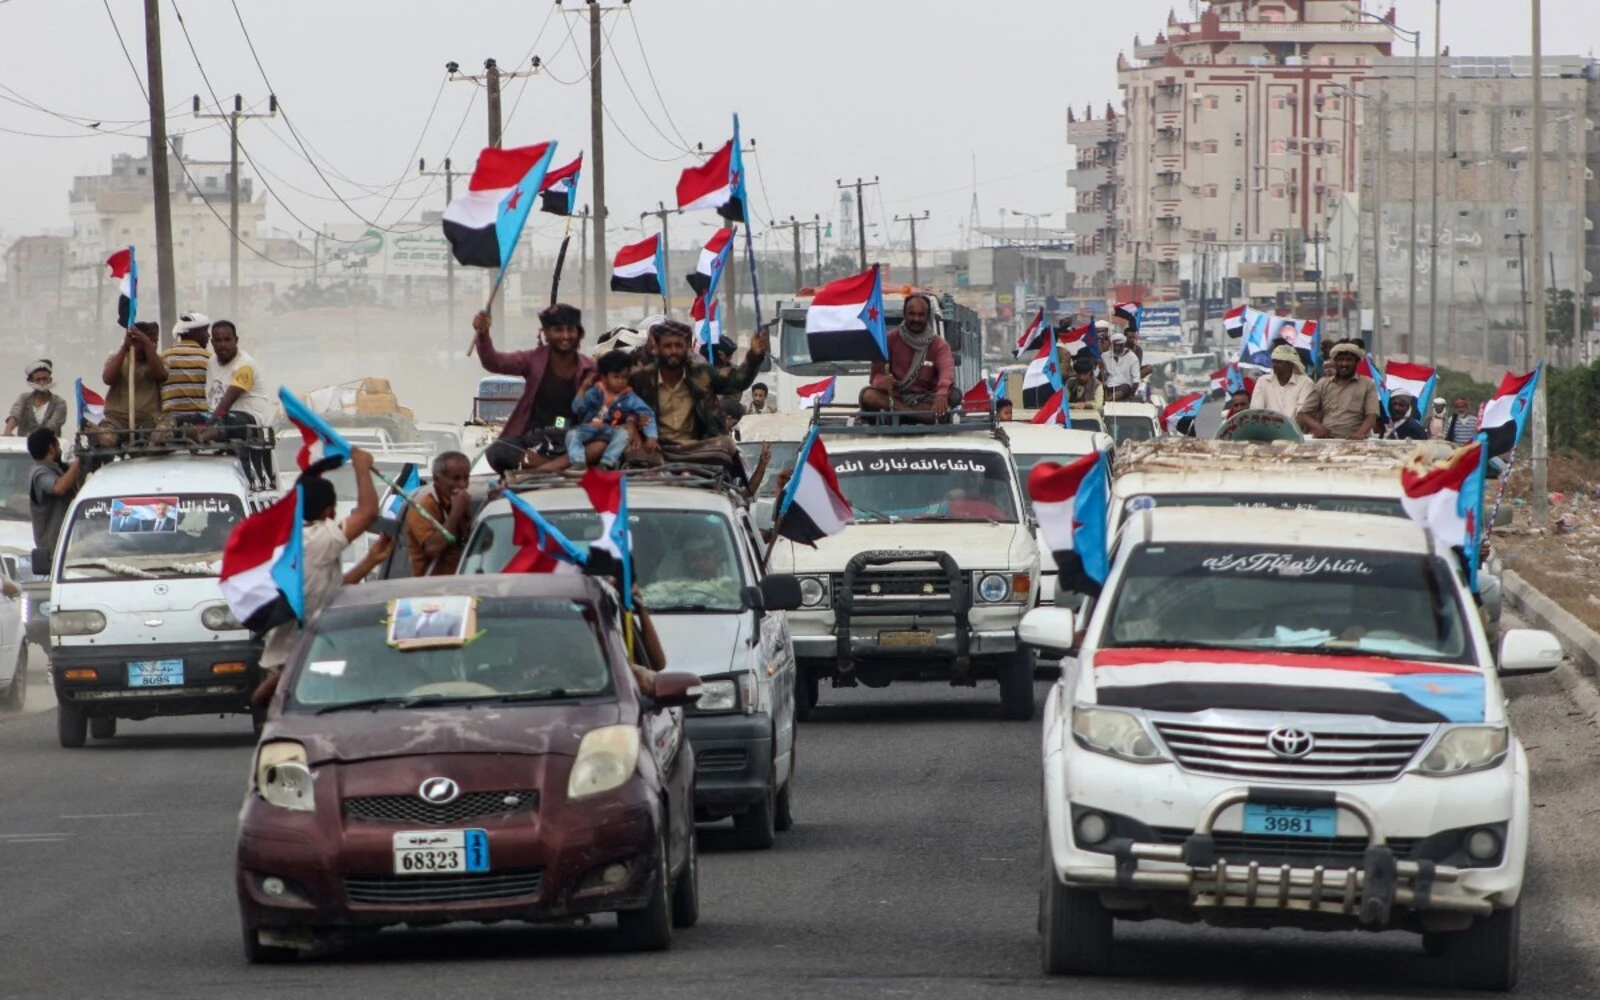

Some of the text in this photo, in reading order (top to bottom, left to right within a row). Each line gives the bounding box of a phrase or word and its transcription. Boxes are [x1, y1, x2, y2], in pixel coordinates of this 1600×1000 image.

[834, 459, 864, 473] الله
[1264, 816, 1313, 833] 3981
[402, 851, 459, 871] 68323
